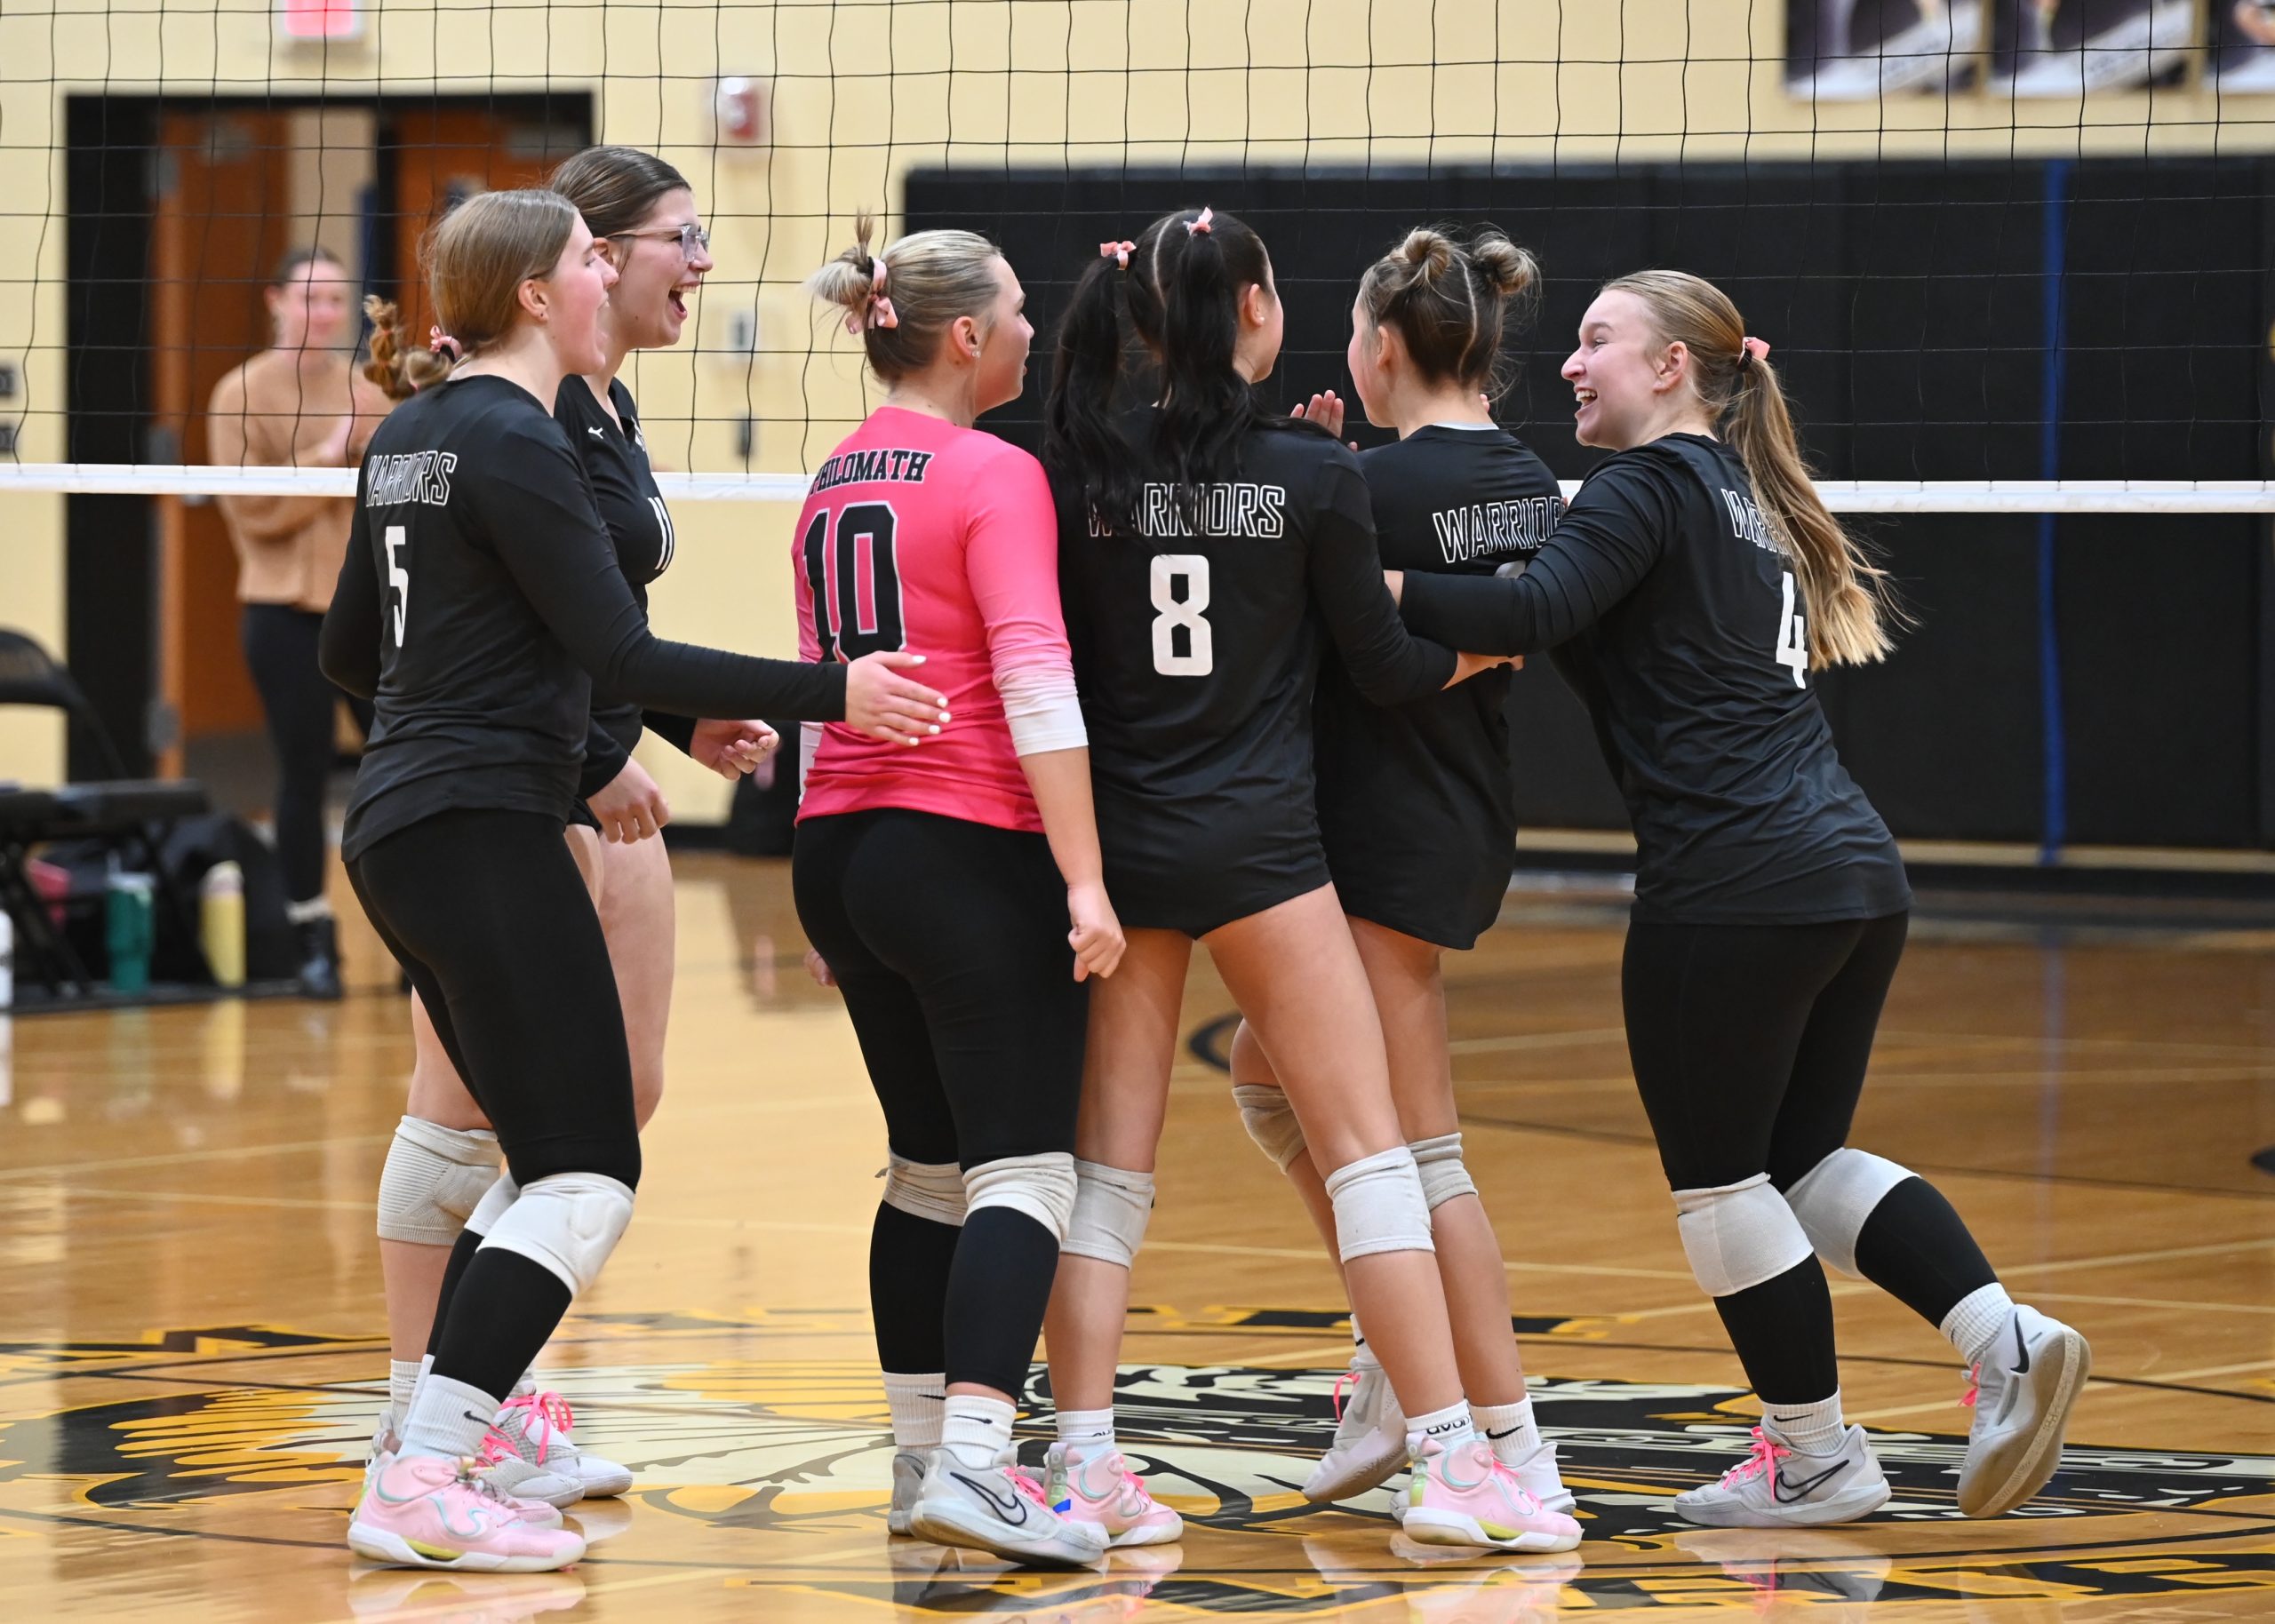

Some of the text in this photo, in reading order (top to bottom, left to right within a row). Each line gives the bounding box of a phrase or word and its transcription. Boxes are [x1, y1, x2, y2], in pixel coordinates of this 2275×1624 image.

[385, 526, 409, 648] 5
[803, 500, 906, 661] 10
[1150, 553, 1213, 676] 8
[1776, 571, 1808, 689] 4
